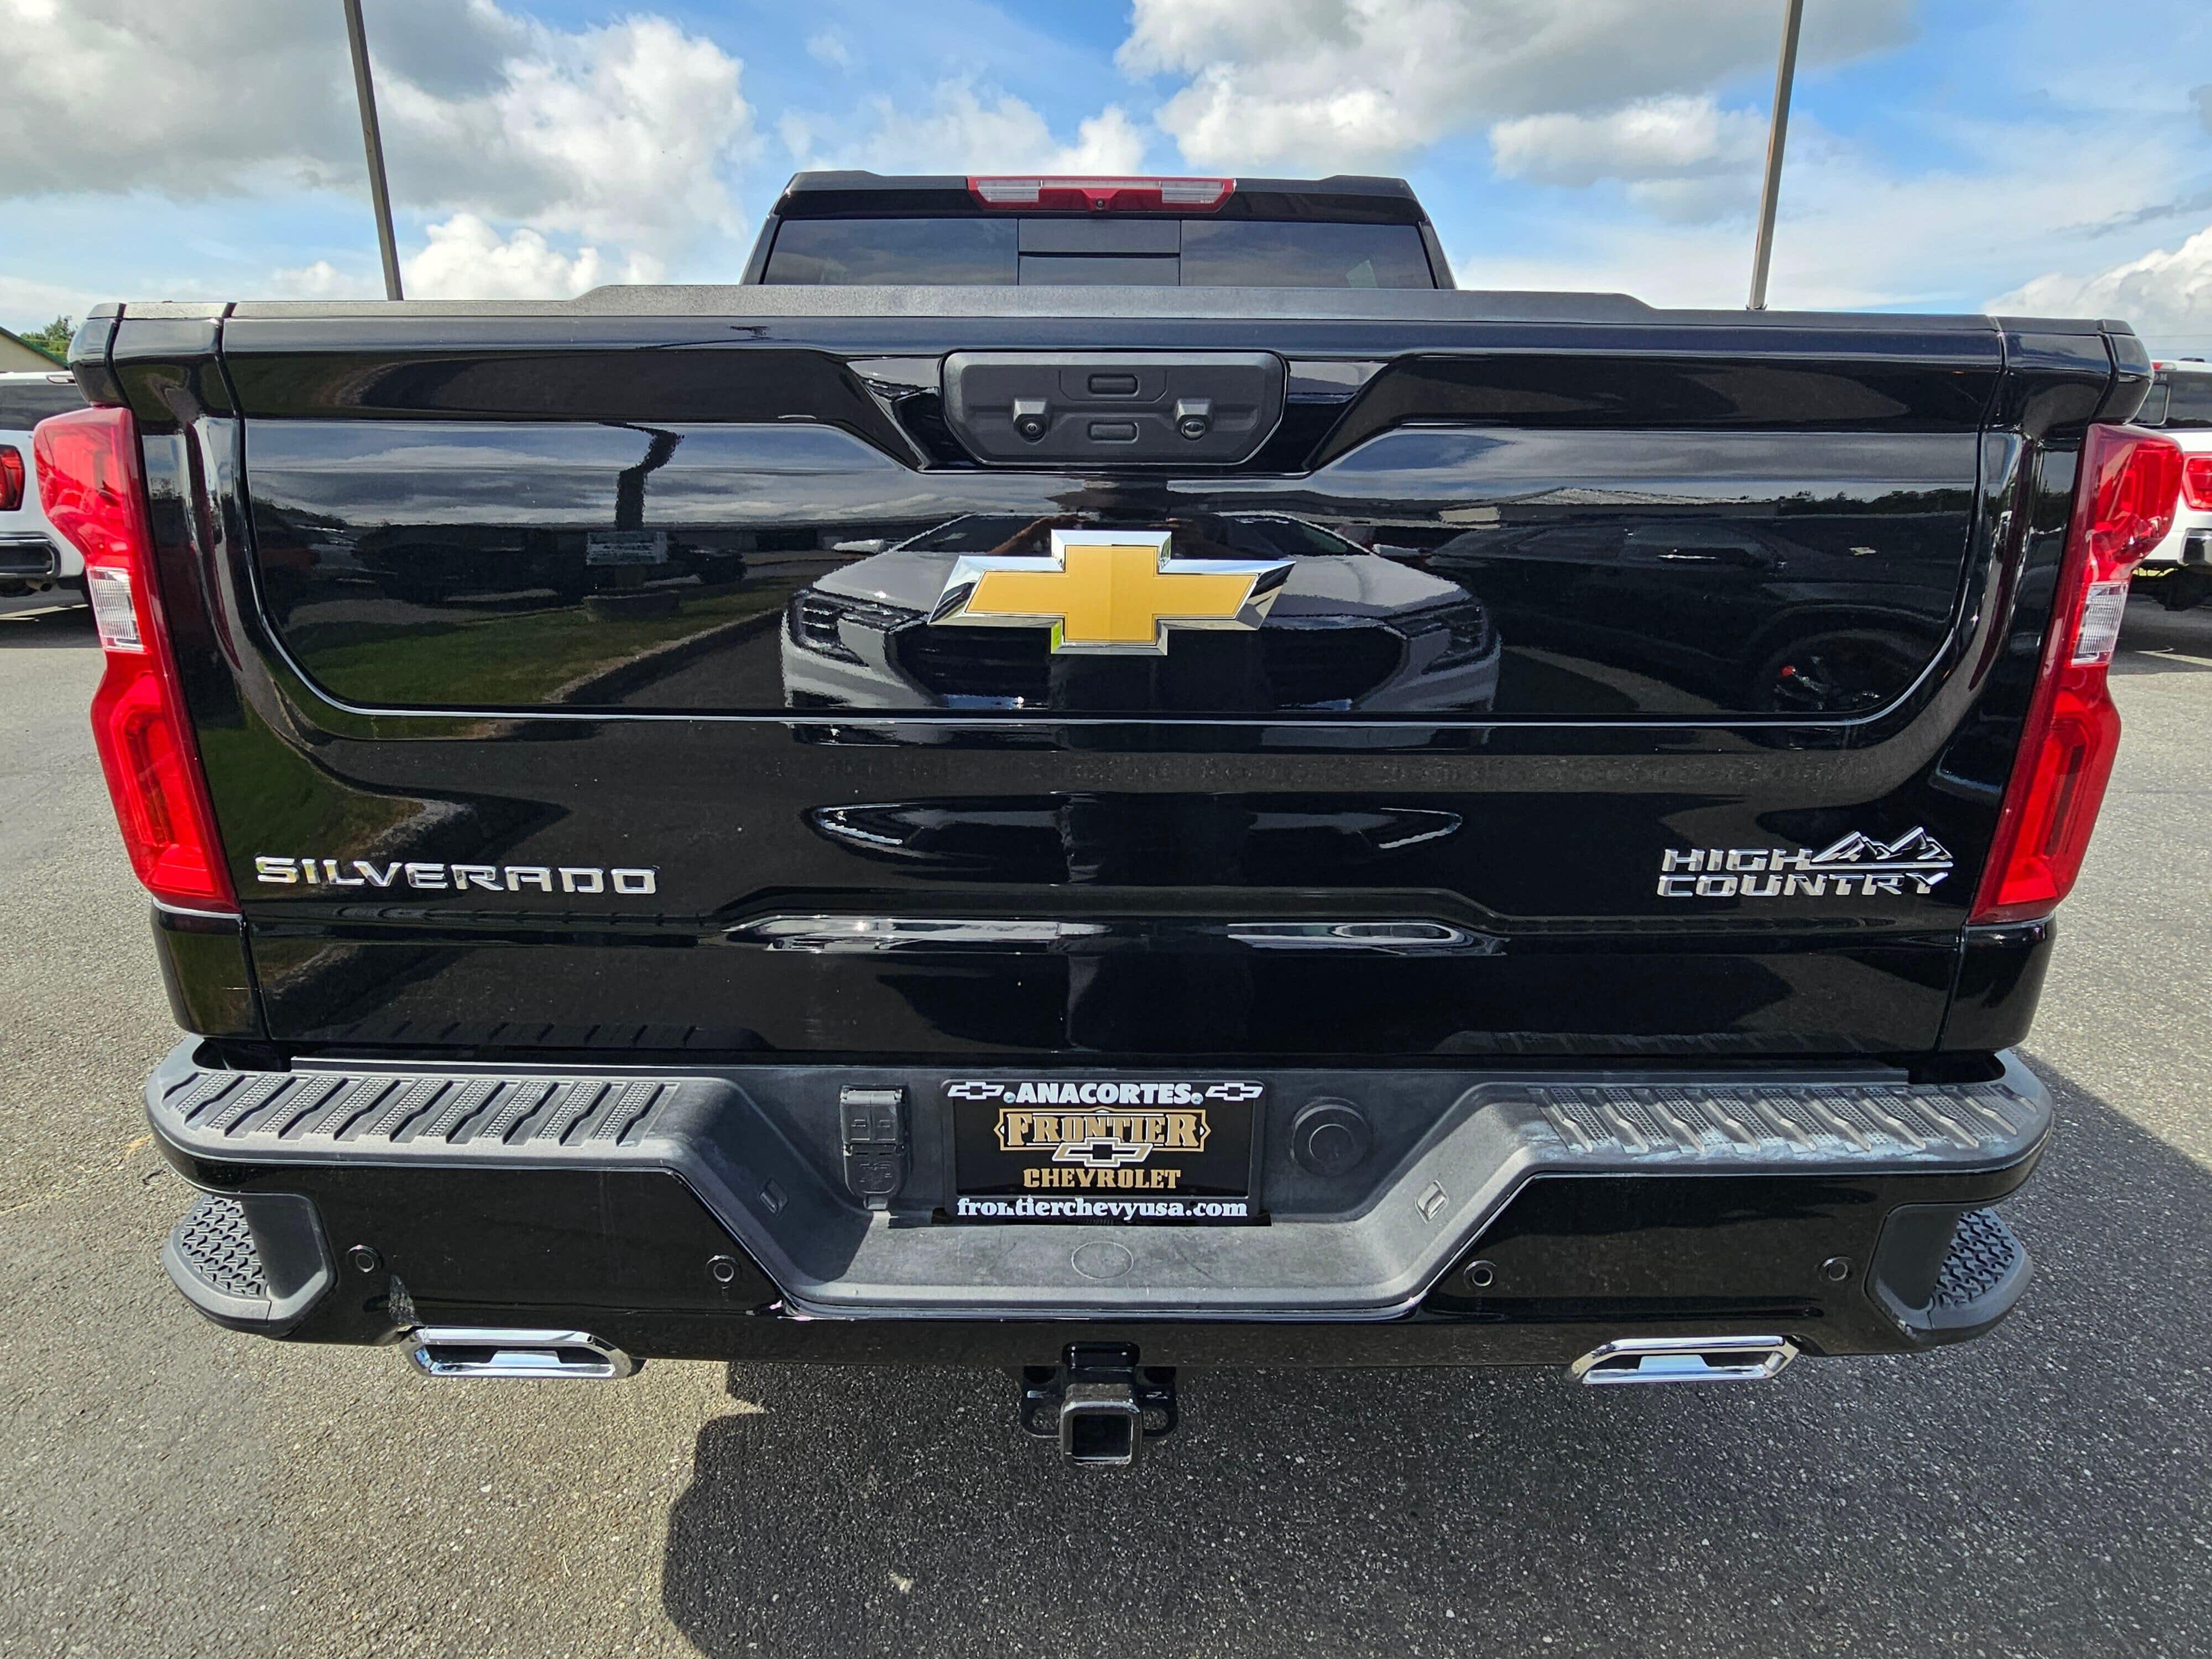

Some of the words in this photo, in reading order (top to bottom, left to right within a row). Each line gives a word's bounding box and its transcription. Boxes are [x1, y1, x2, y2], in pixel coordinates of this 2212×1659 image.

[1661, 848, 1812, 871] HIGH
[255, 856, 658, 894] SILVERADO
[1657, 872, 1948, 896] COUNTRY
[1016, 1082, 1192, 1104] ANACORTES
[1007, 1114, 1199, 1146] FRONTIER
[1023, 1168, 1181, 1188] CHEVROLET
[957, 1198, 1247, 1220] frontierchevyusa.com
